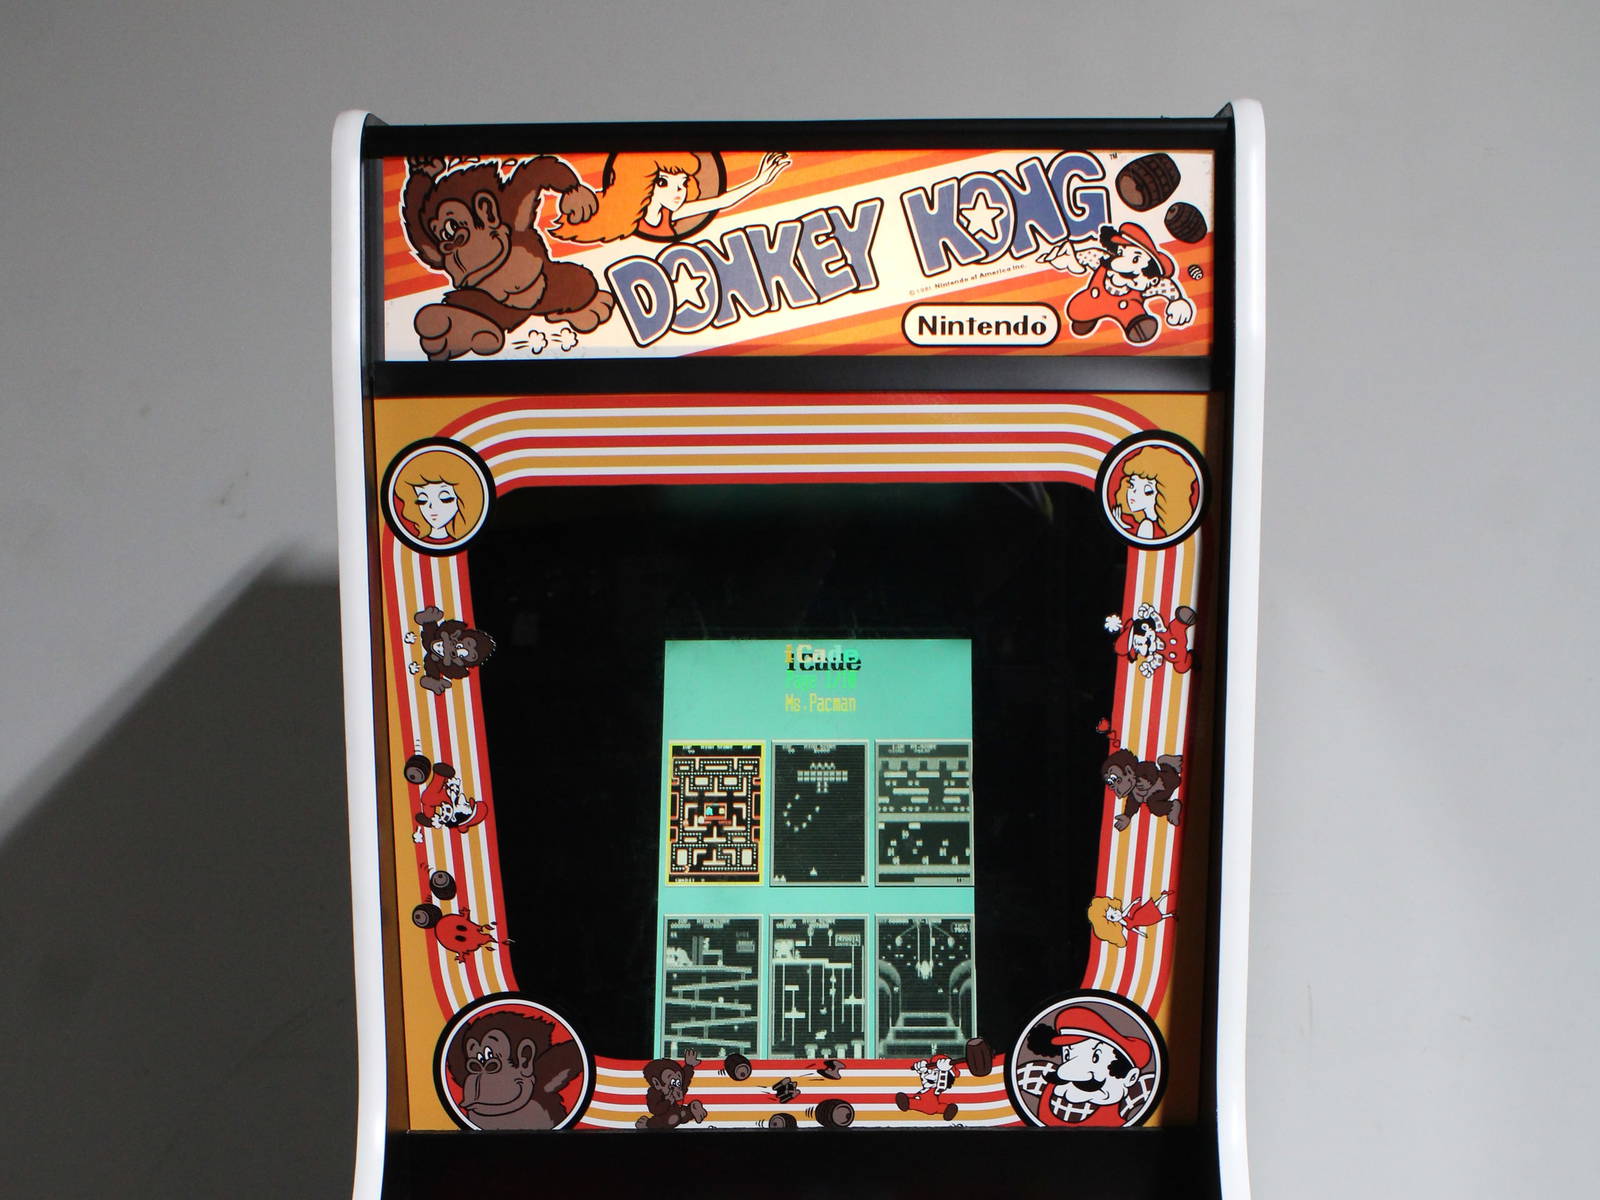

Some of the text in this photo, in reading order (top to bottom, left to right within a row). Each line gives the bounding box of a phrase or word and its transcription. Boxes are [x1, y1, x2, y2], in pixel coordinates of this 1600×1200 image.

[604, 198, 884, 347] DONKEY
[901, 149, 1111, 277] KONG
[918, 315, 1047, 336] Nintendo
